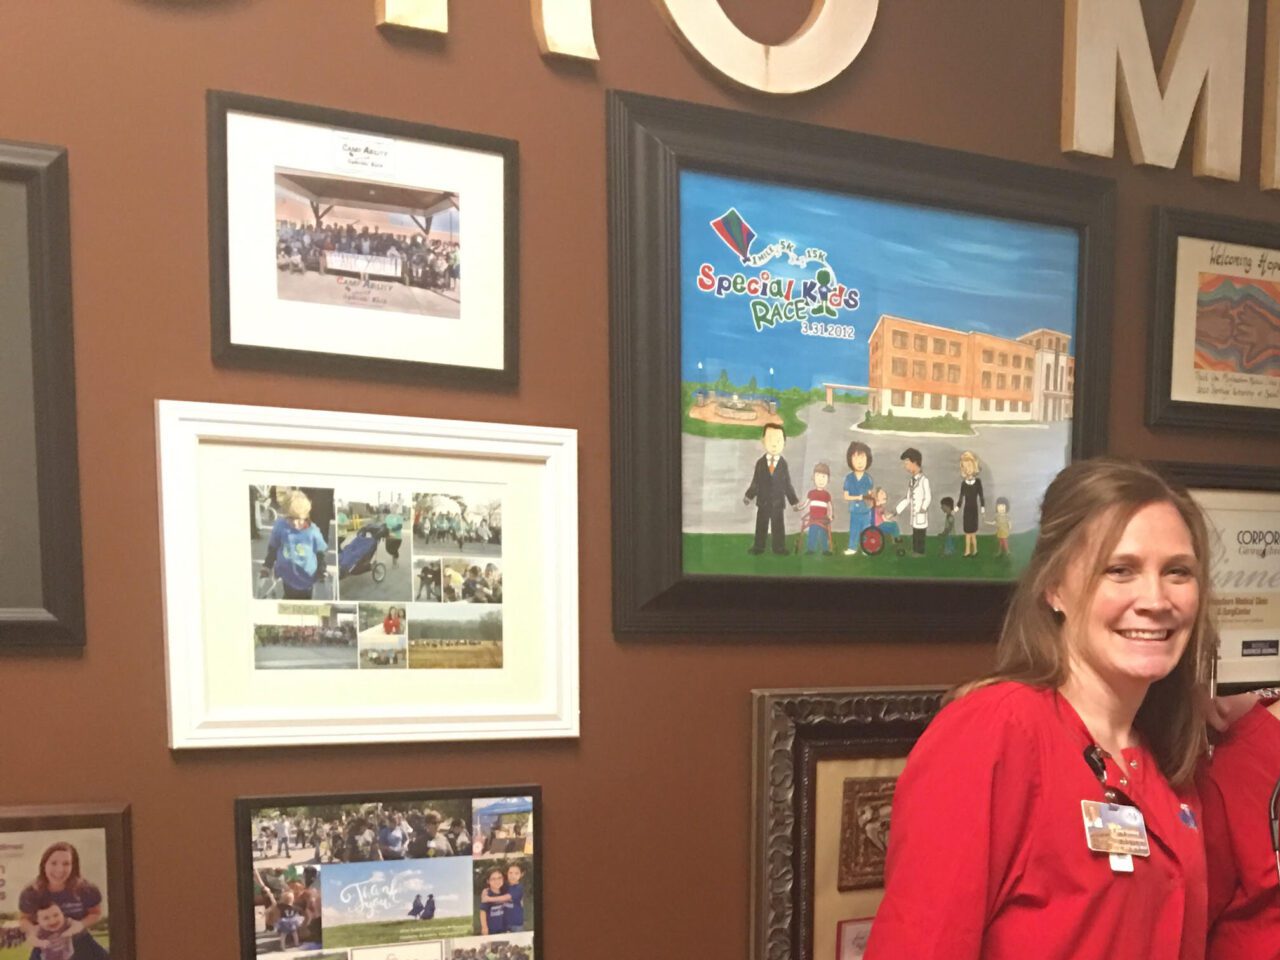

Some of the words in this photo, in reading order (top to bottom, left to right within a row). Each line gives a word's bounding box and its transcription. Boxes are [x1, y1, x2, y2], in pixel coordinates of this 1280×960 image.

[780, 240, 794, 252] 5K
[806, 249, 826, 262] 15K
[1209, 244, 1252, 273] Welcoming
[698, 264, 794, 302] Special
[802, 270, 859, 316] Kids
[751, 300, 808, 331] RACE
[801, 322, 855, 339] 3.31.2012
